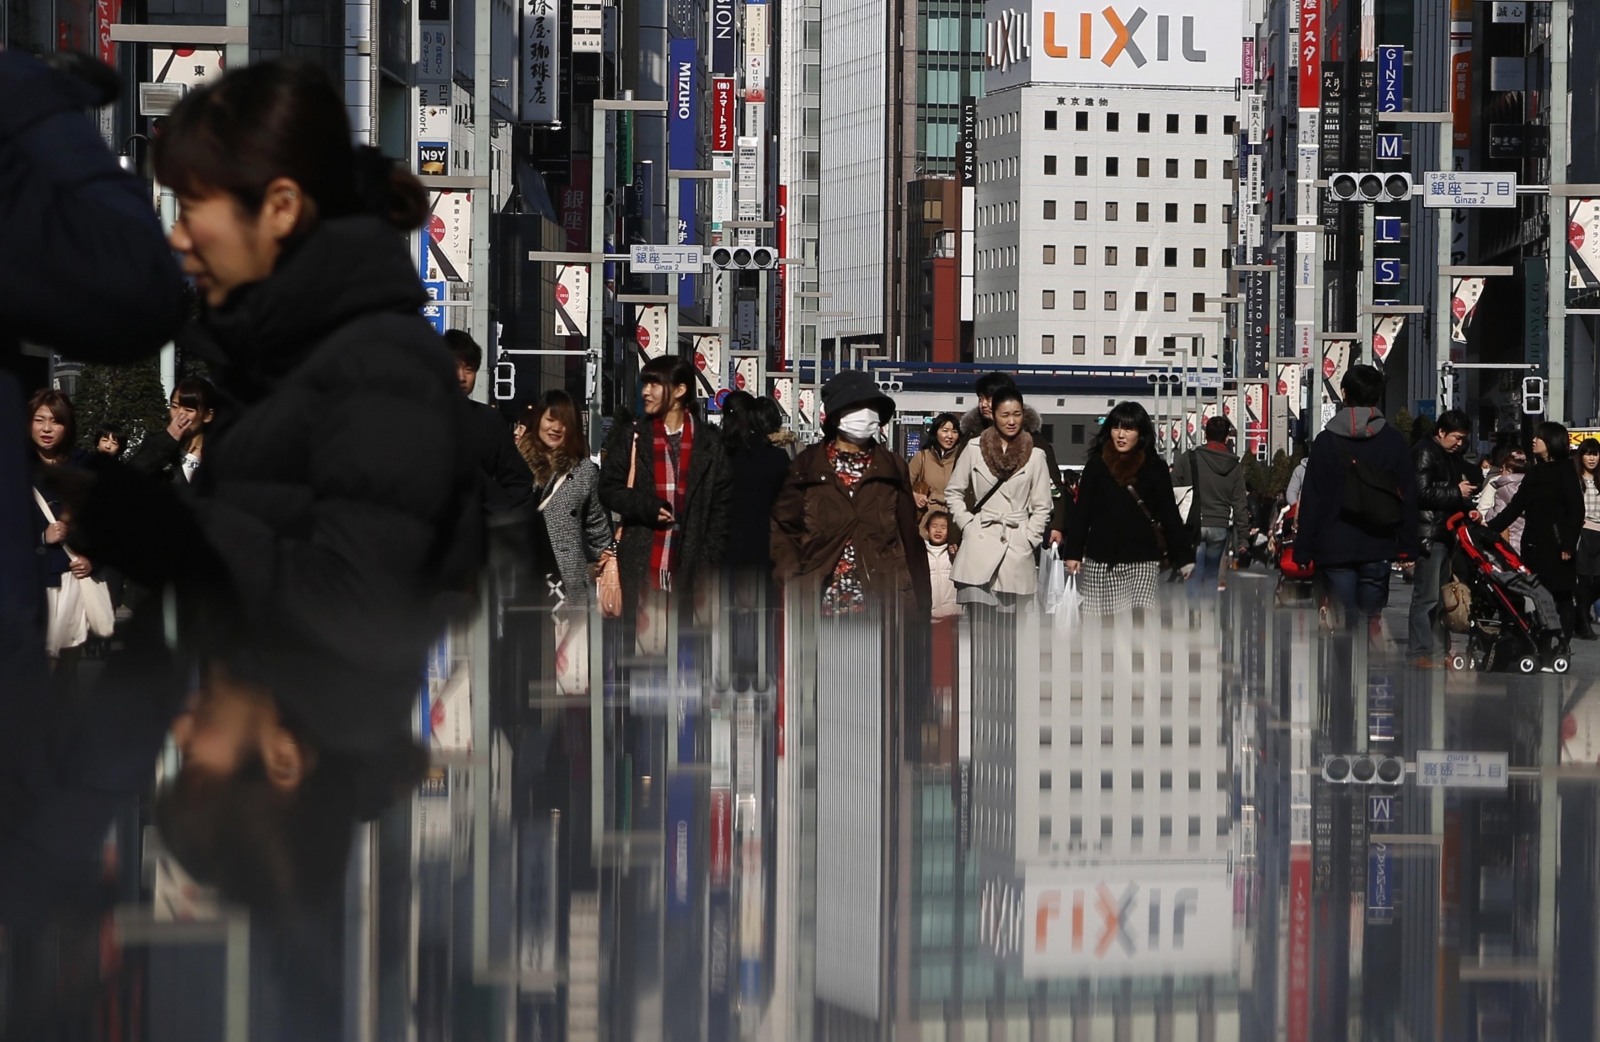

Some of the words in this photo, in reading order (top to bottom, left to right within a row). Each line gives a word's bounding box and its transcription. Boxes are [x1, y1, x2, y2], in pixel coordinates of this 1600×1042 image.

[986, 8, 1031, 71] LIXIL
[1043, 5, 1207, 68] LIXIL
[438, 84, 447, 115] ELITE
[678, 62, 691, 119] MIZUHO
[1056, 96, 1109, 107] 東京建物
[421, 150, 445, 161] N9Y
[1382, 136, 1398, 157] M
[1430, 173, 1456, 181] 中央区
[1431, 181, 1510, 196] 銀座二丁目
[635, 252, 698, 264] 銀座二丁目
